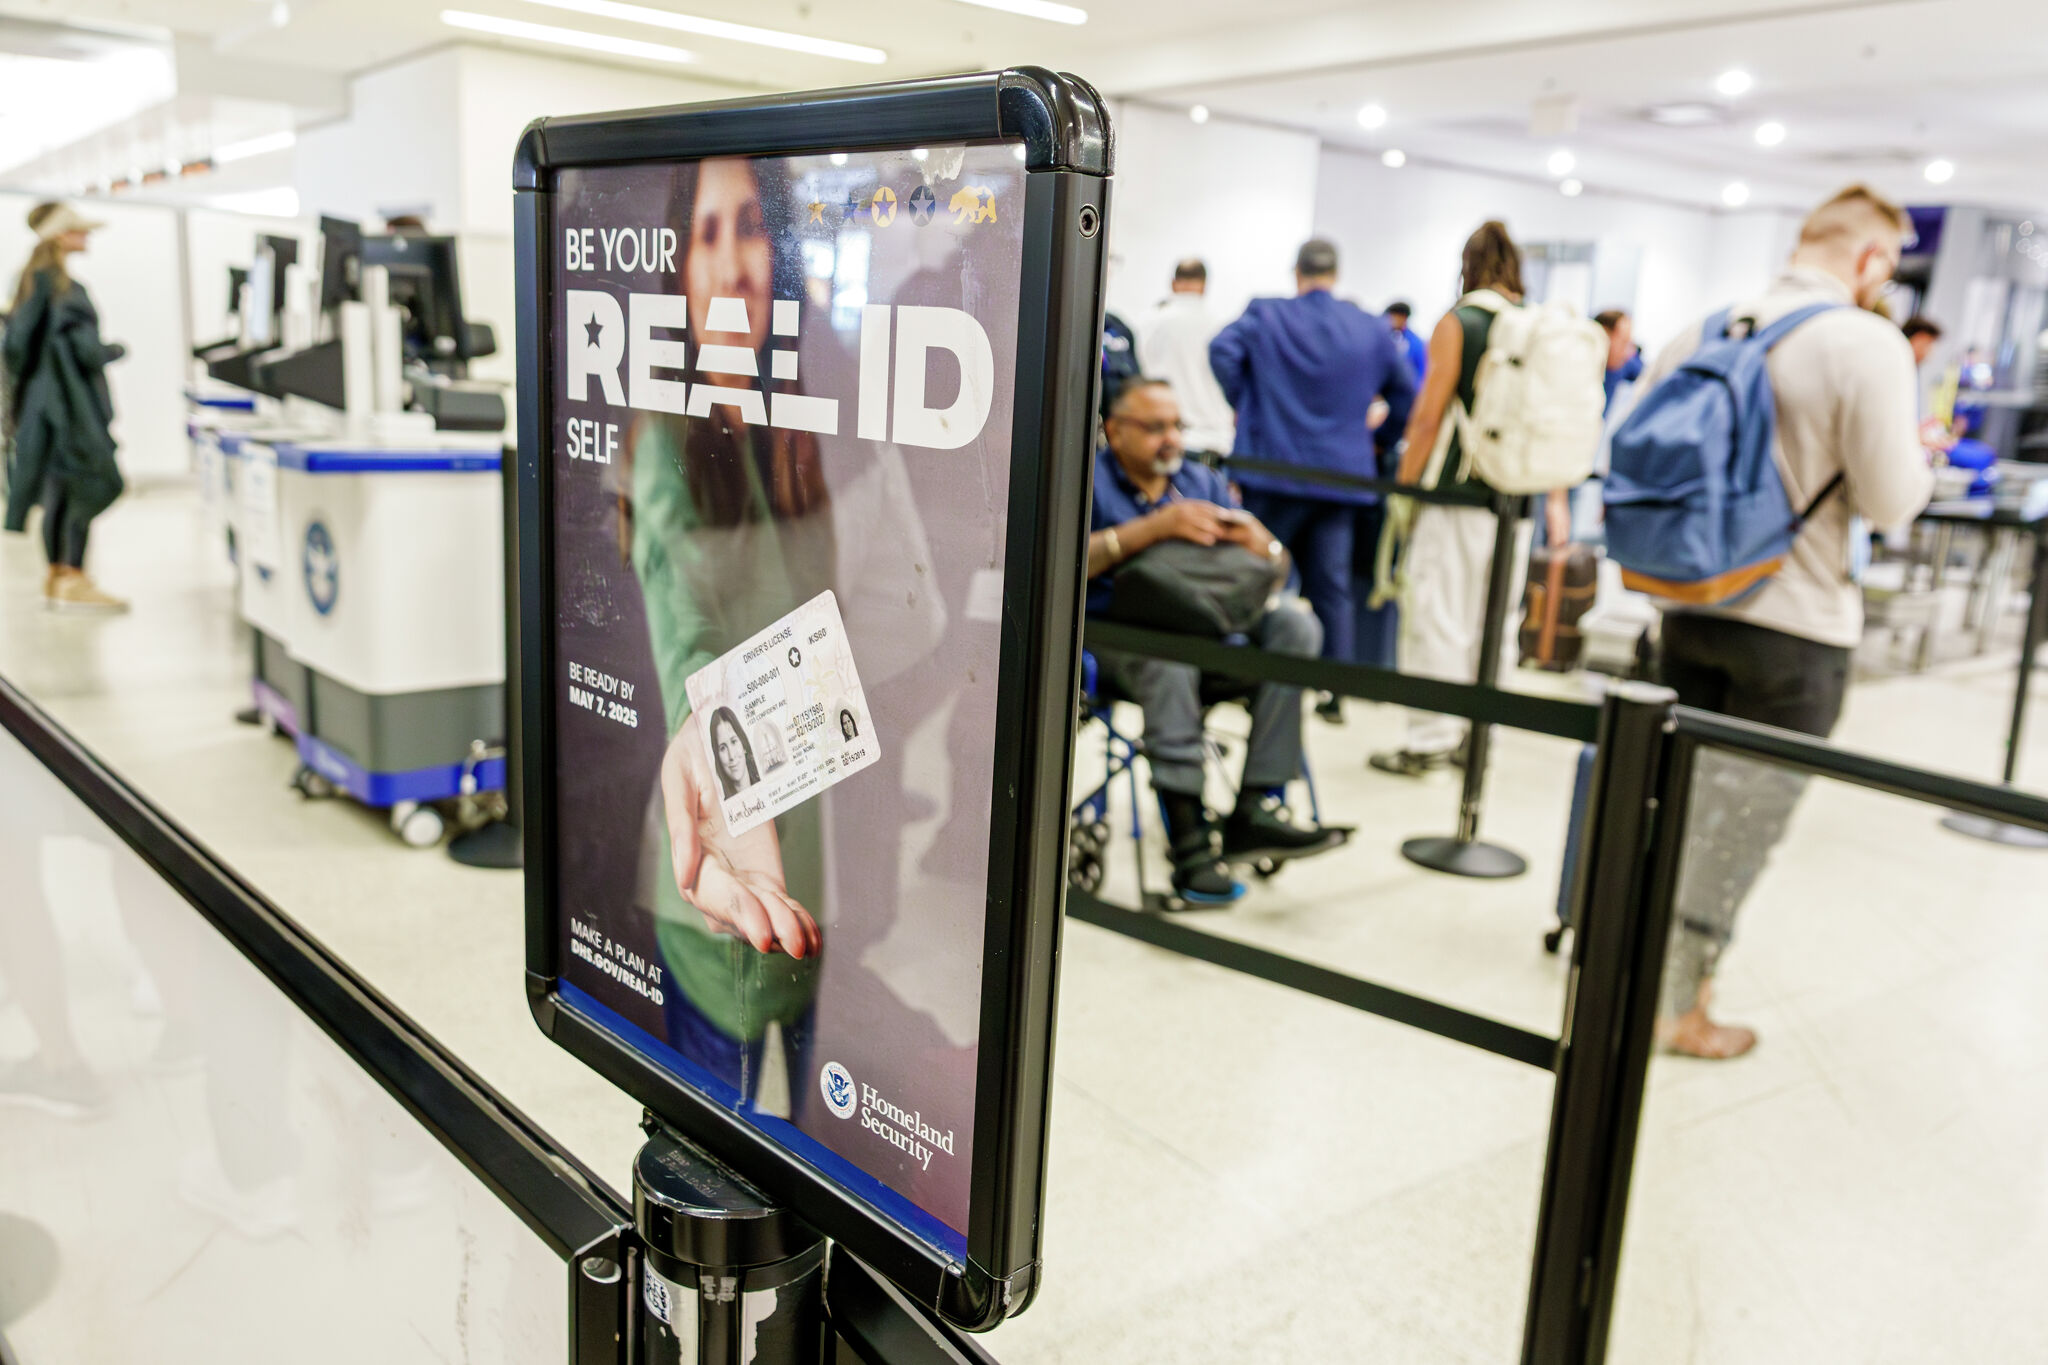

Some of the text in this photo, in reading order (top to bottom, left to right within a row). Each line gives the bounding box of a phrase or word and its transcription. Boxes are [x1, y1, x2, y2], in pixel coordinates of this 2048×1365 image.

[566, 228, 677, 274] BE YOUR
[566, 290, 994, 450] REAL ID
[566, 417, 618, 465] SELF
[743, 627, 792, 664] DRIVER'S LICENSE
[569, 661, 635, 701] BE READY BY
[569, 685, 594, 710] MAY
[608, 701, 638, 728] 2025
[571, 917, 662, 984] MAKE A PLAN AT
[571, 938, 664, 1006] DHS.GOV/REAL-ID
[861, 1082, 955, 1156] Homeland
[861, 1106, 933, 1171] Security
